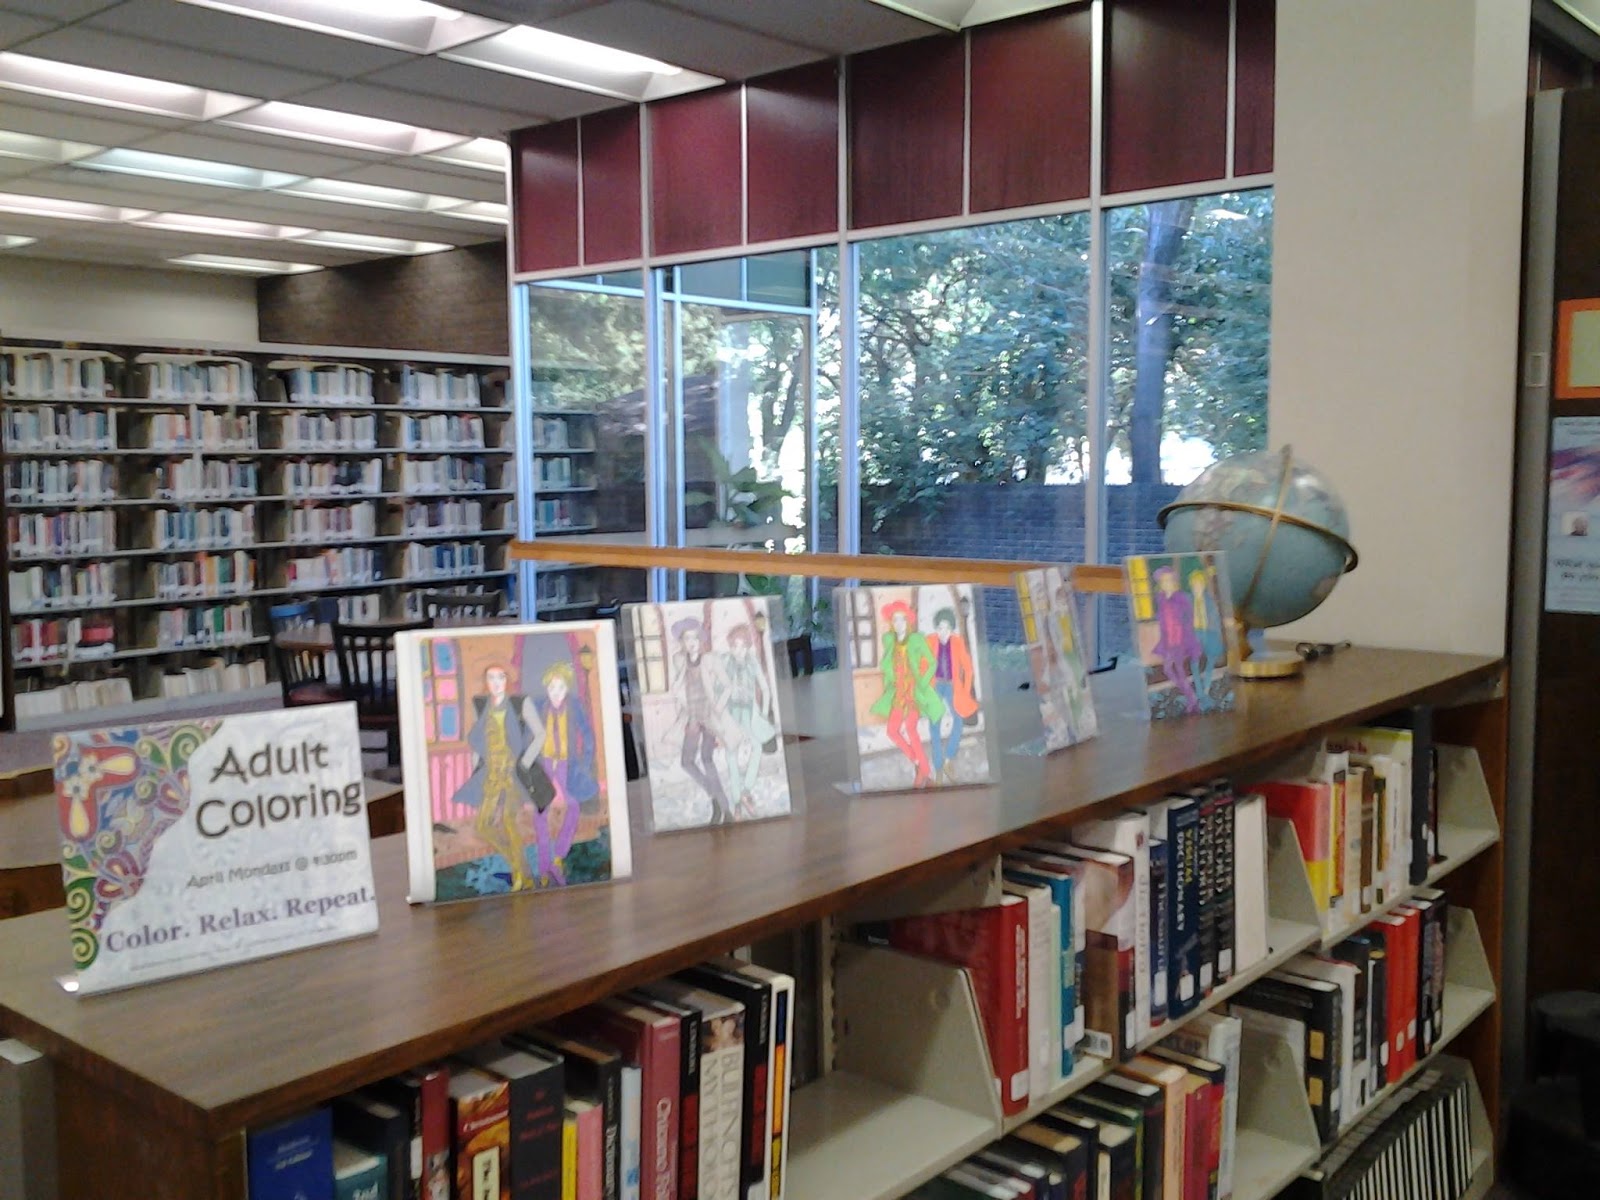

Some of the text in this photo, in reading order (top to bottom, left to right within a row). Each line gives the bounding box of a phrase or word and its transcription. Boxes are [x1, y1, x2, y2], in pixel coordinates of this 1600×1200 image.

[209, 741, 329, 784] Adult
[196, 782, 361, 839] Coloring
[186, 871, 224, 889] April
[295, 856, 309, 871] @
[106, 924, 191, 952] Color.
[199, 907, 279, 935] Relax.
[286, 887, 376, 917] Repeat.
